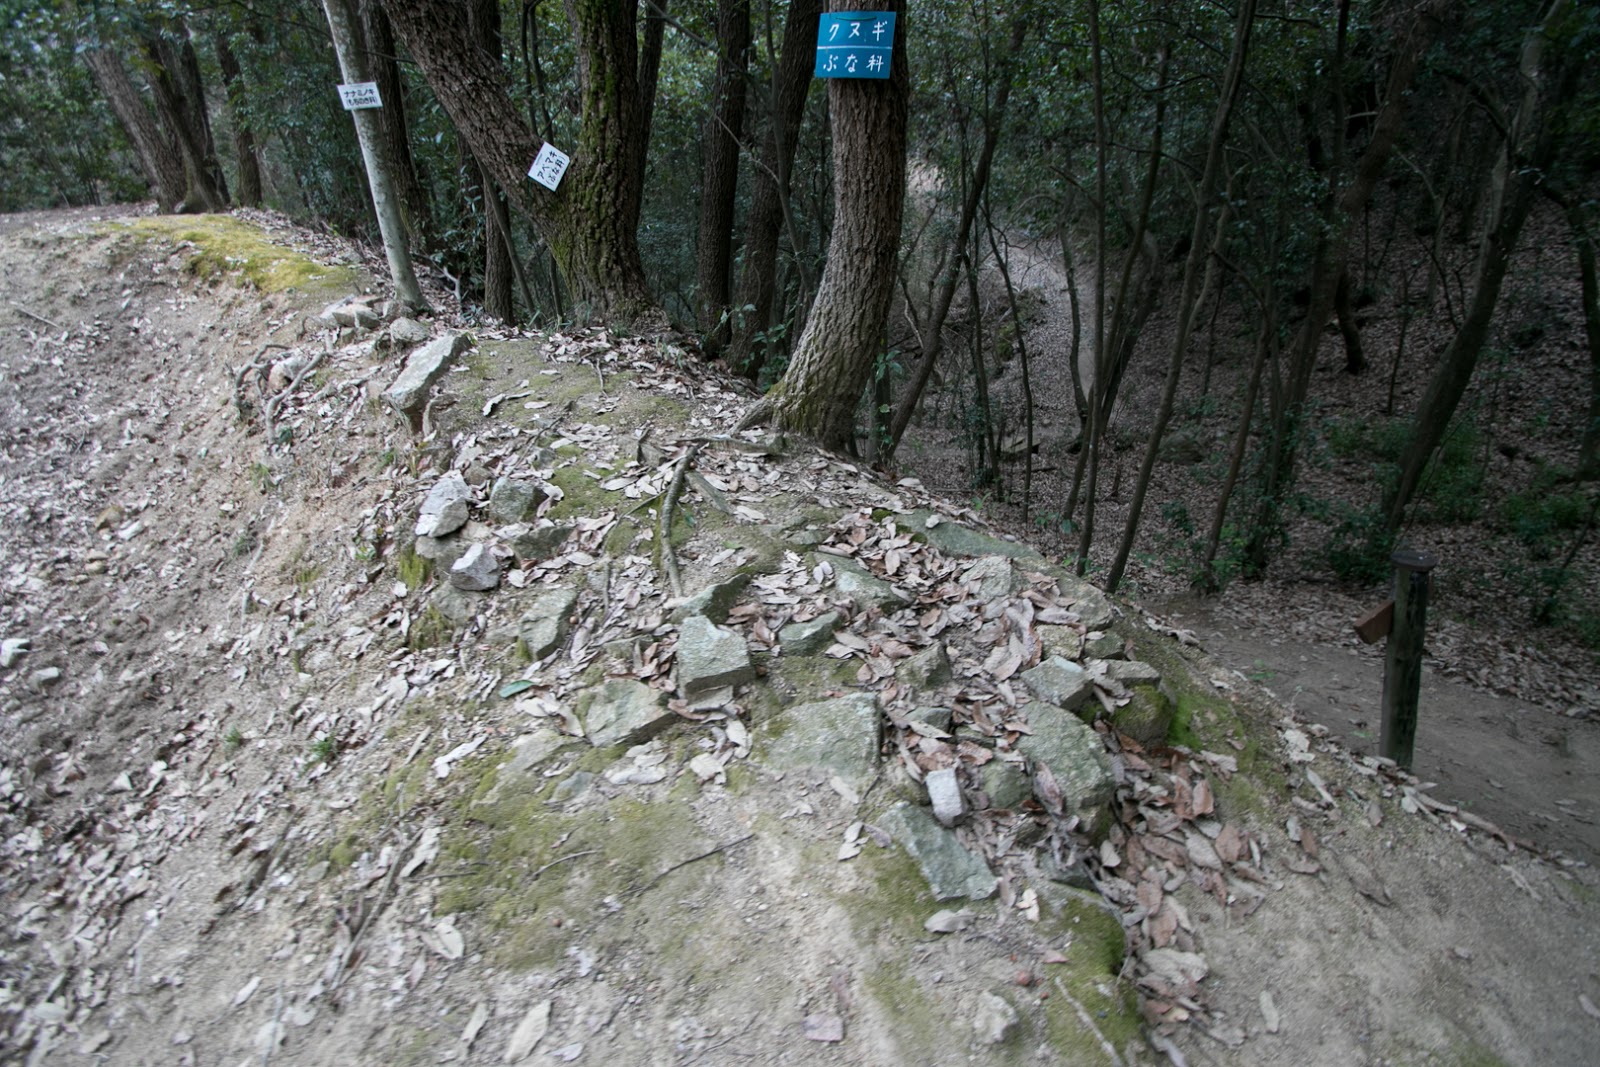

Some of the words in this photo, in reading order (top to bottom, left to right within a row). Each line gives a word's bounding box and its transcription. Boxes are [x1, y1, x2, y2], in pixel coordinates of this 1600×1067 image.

[828, 20, 888, 42] クヌギ
[823, 53, 884, 73] ぶな科
[344, 88, 375, 98] ナナミノキ
[536, 150, 557, 180] アベマキ
